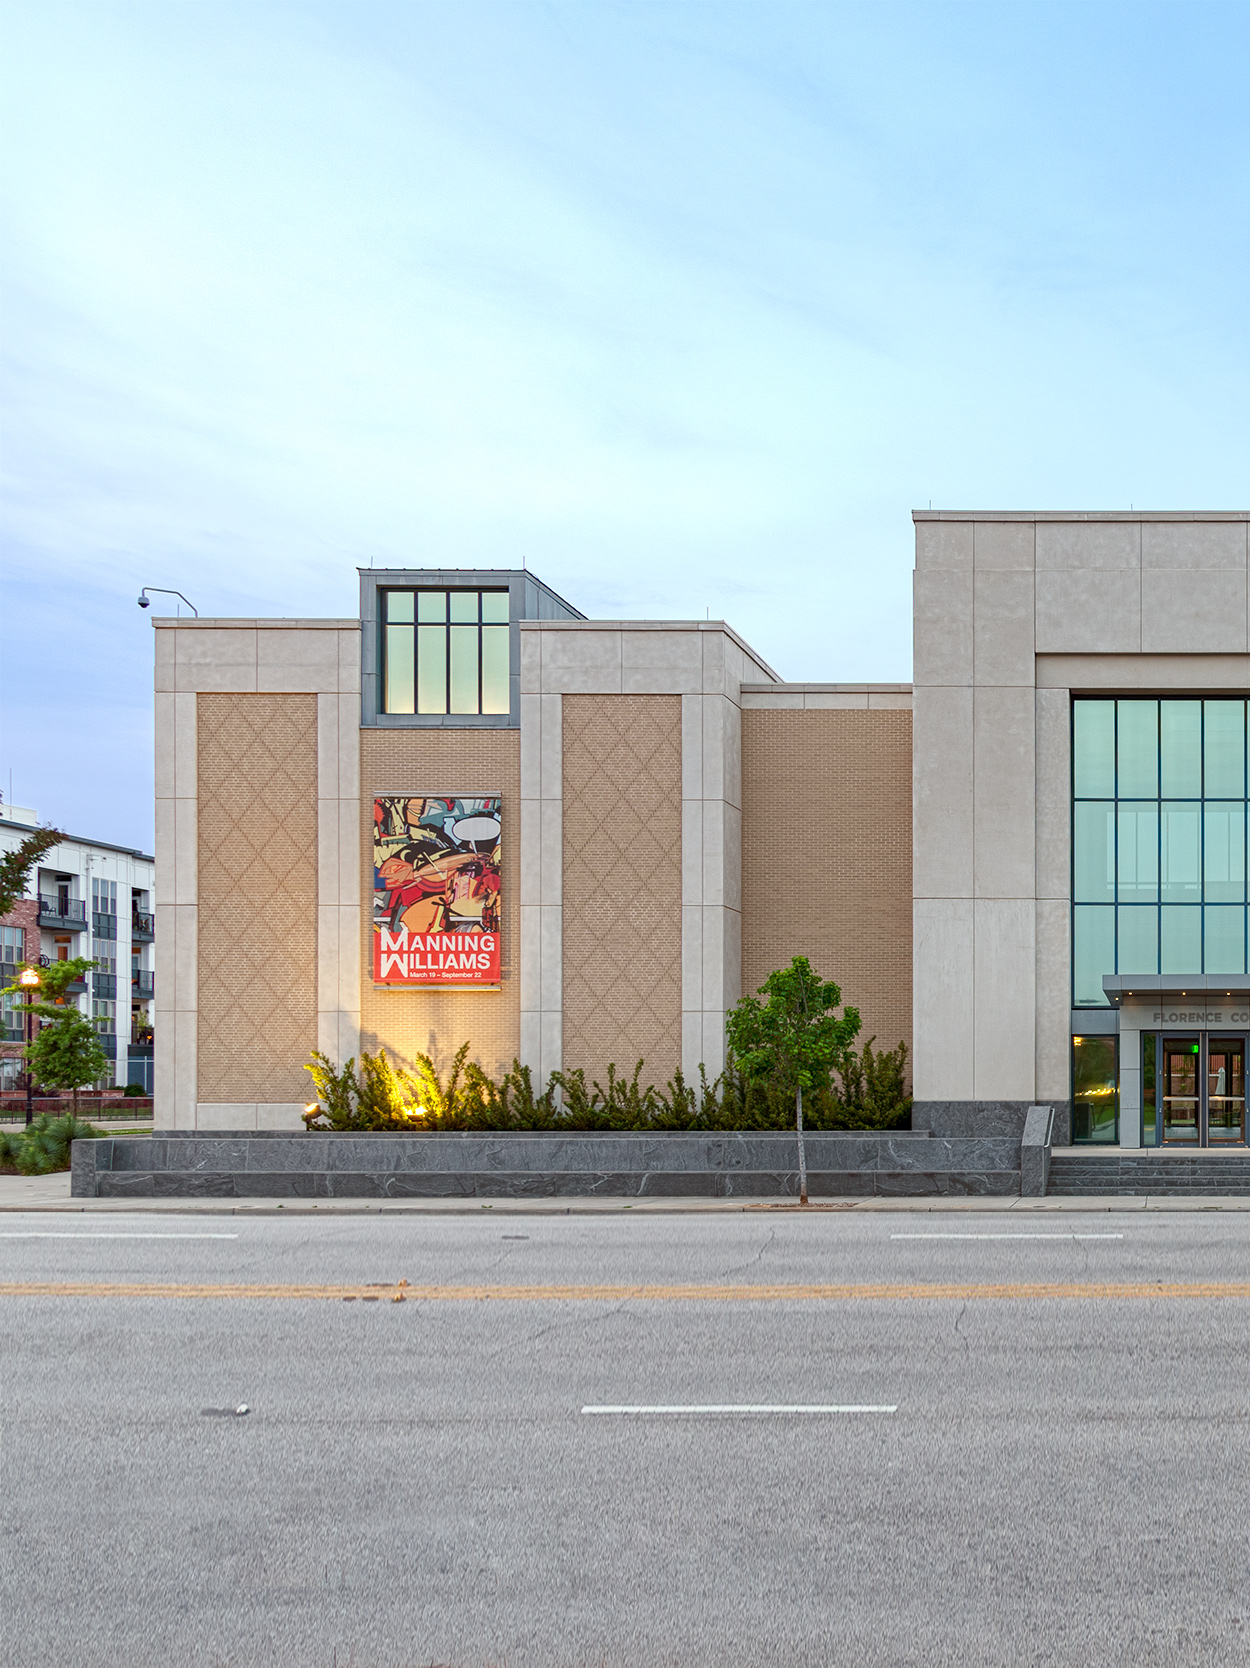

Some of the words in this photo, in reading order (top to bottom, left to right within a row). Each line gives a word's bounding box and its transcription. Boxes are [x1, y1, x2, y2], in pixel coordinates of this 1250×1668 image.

[380, 926, 495, 951] MANNING
[380, 953, 491, 978] WILLIAMS
[1153, 1012, 1222, 1023] FLORENCE
